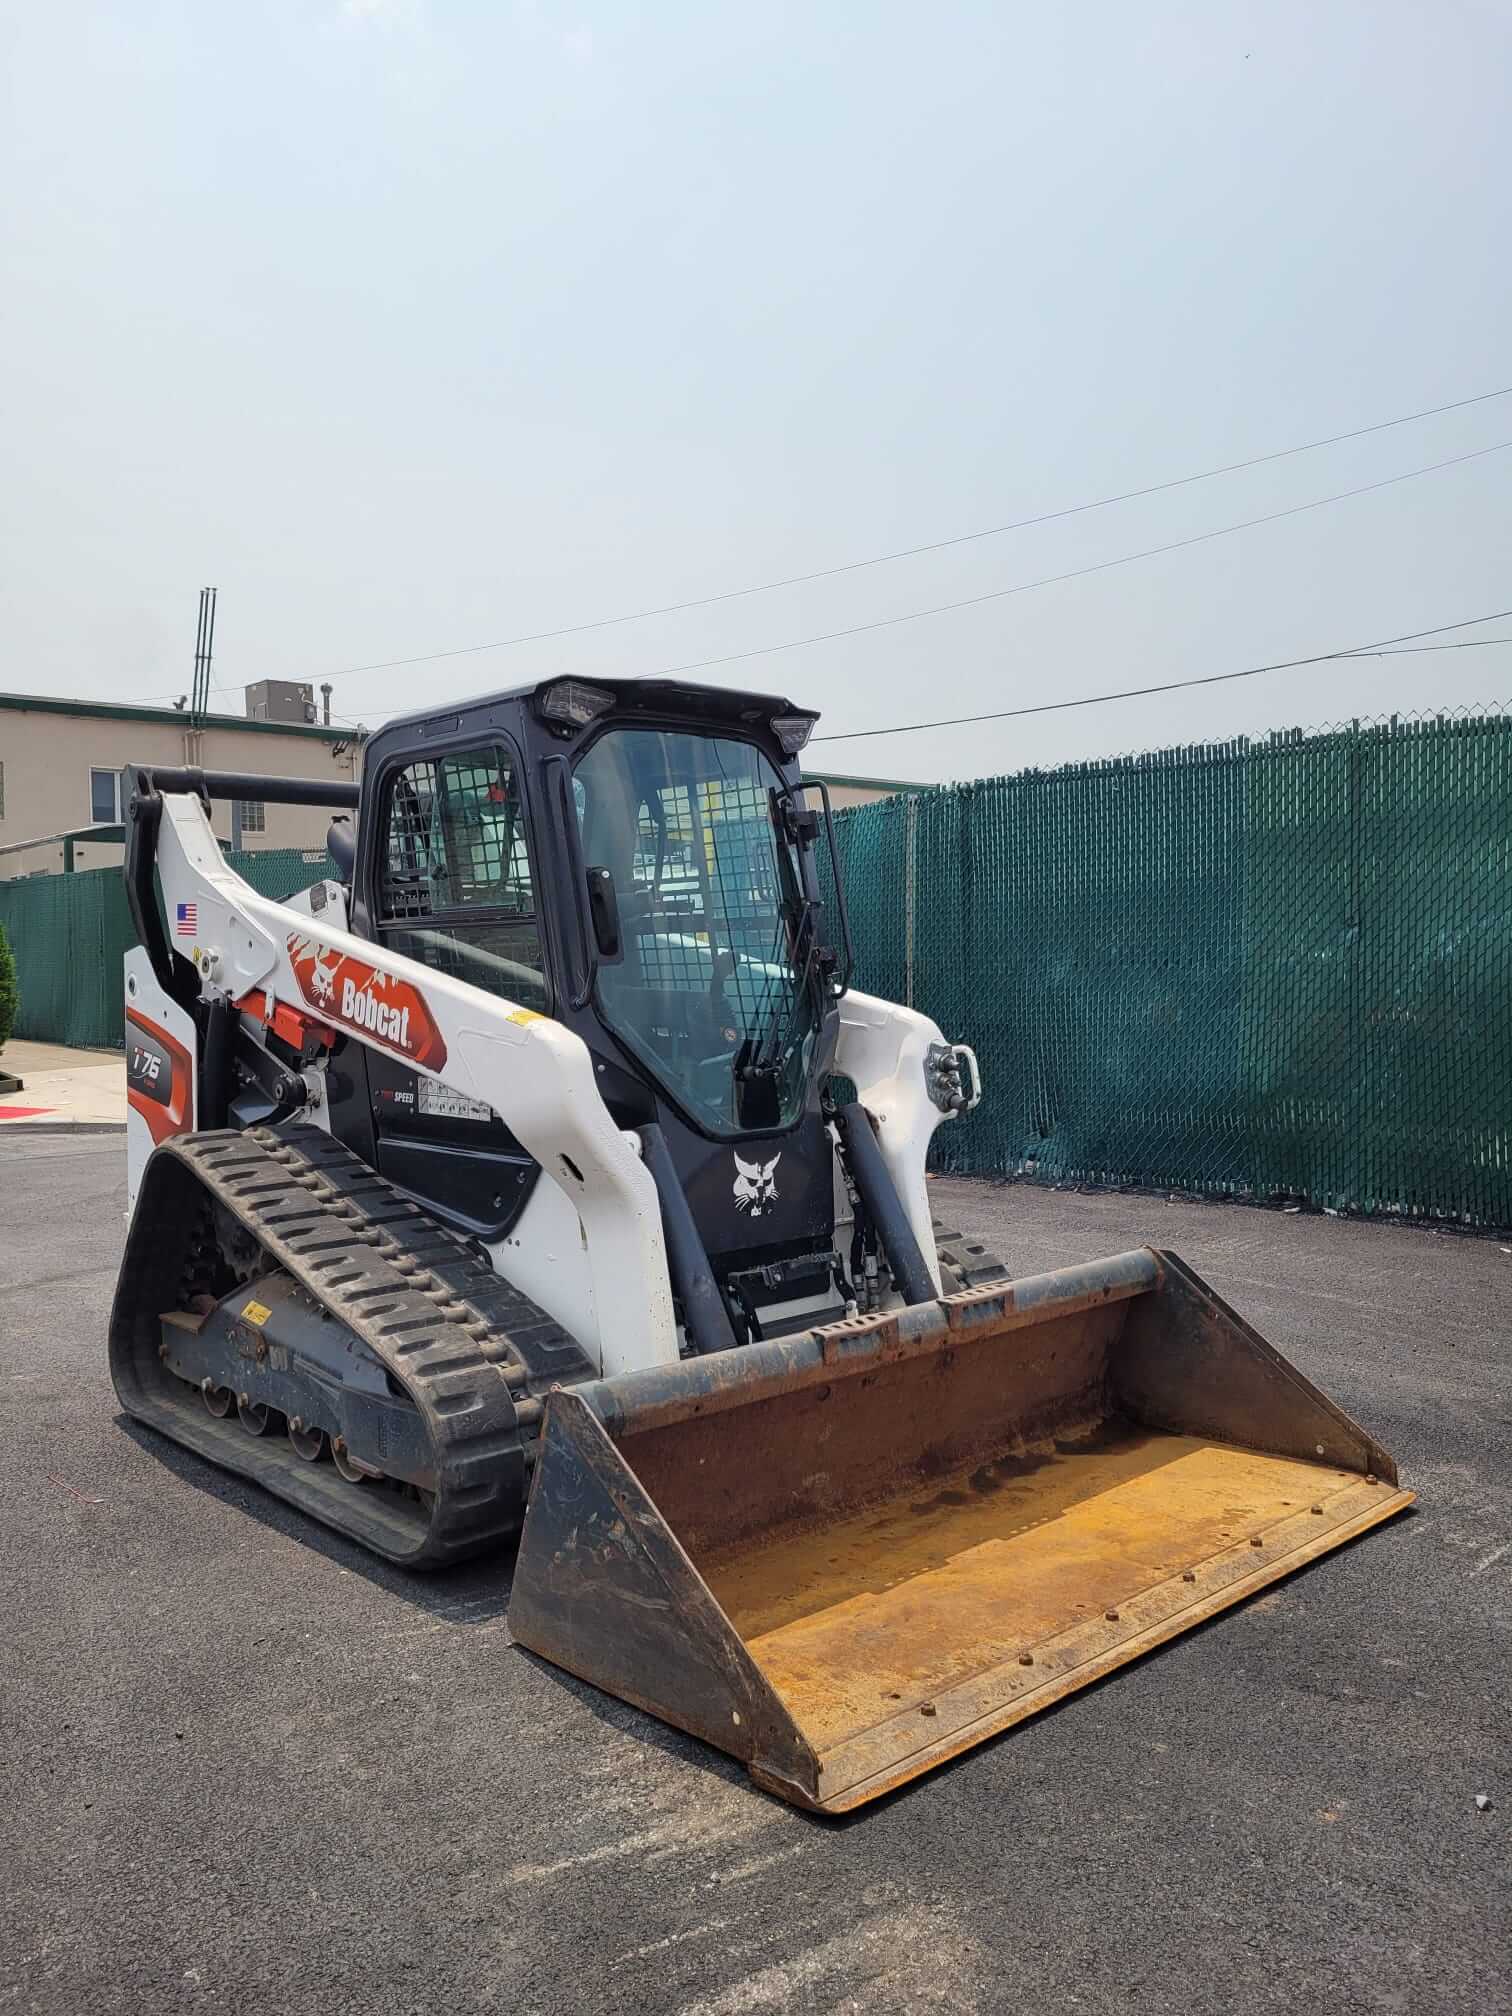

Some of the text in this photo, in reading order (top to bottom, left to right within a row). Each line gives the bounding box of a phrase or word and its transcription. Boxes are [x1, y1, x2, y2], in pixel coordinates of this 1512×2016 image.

[341, 976, 410, 1048] Bobcat
[133, 1047, 162, 1079] T76
[393, 1091, 414, 1103] SPEED
